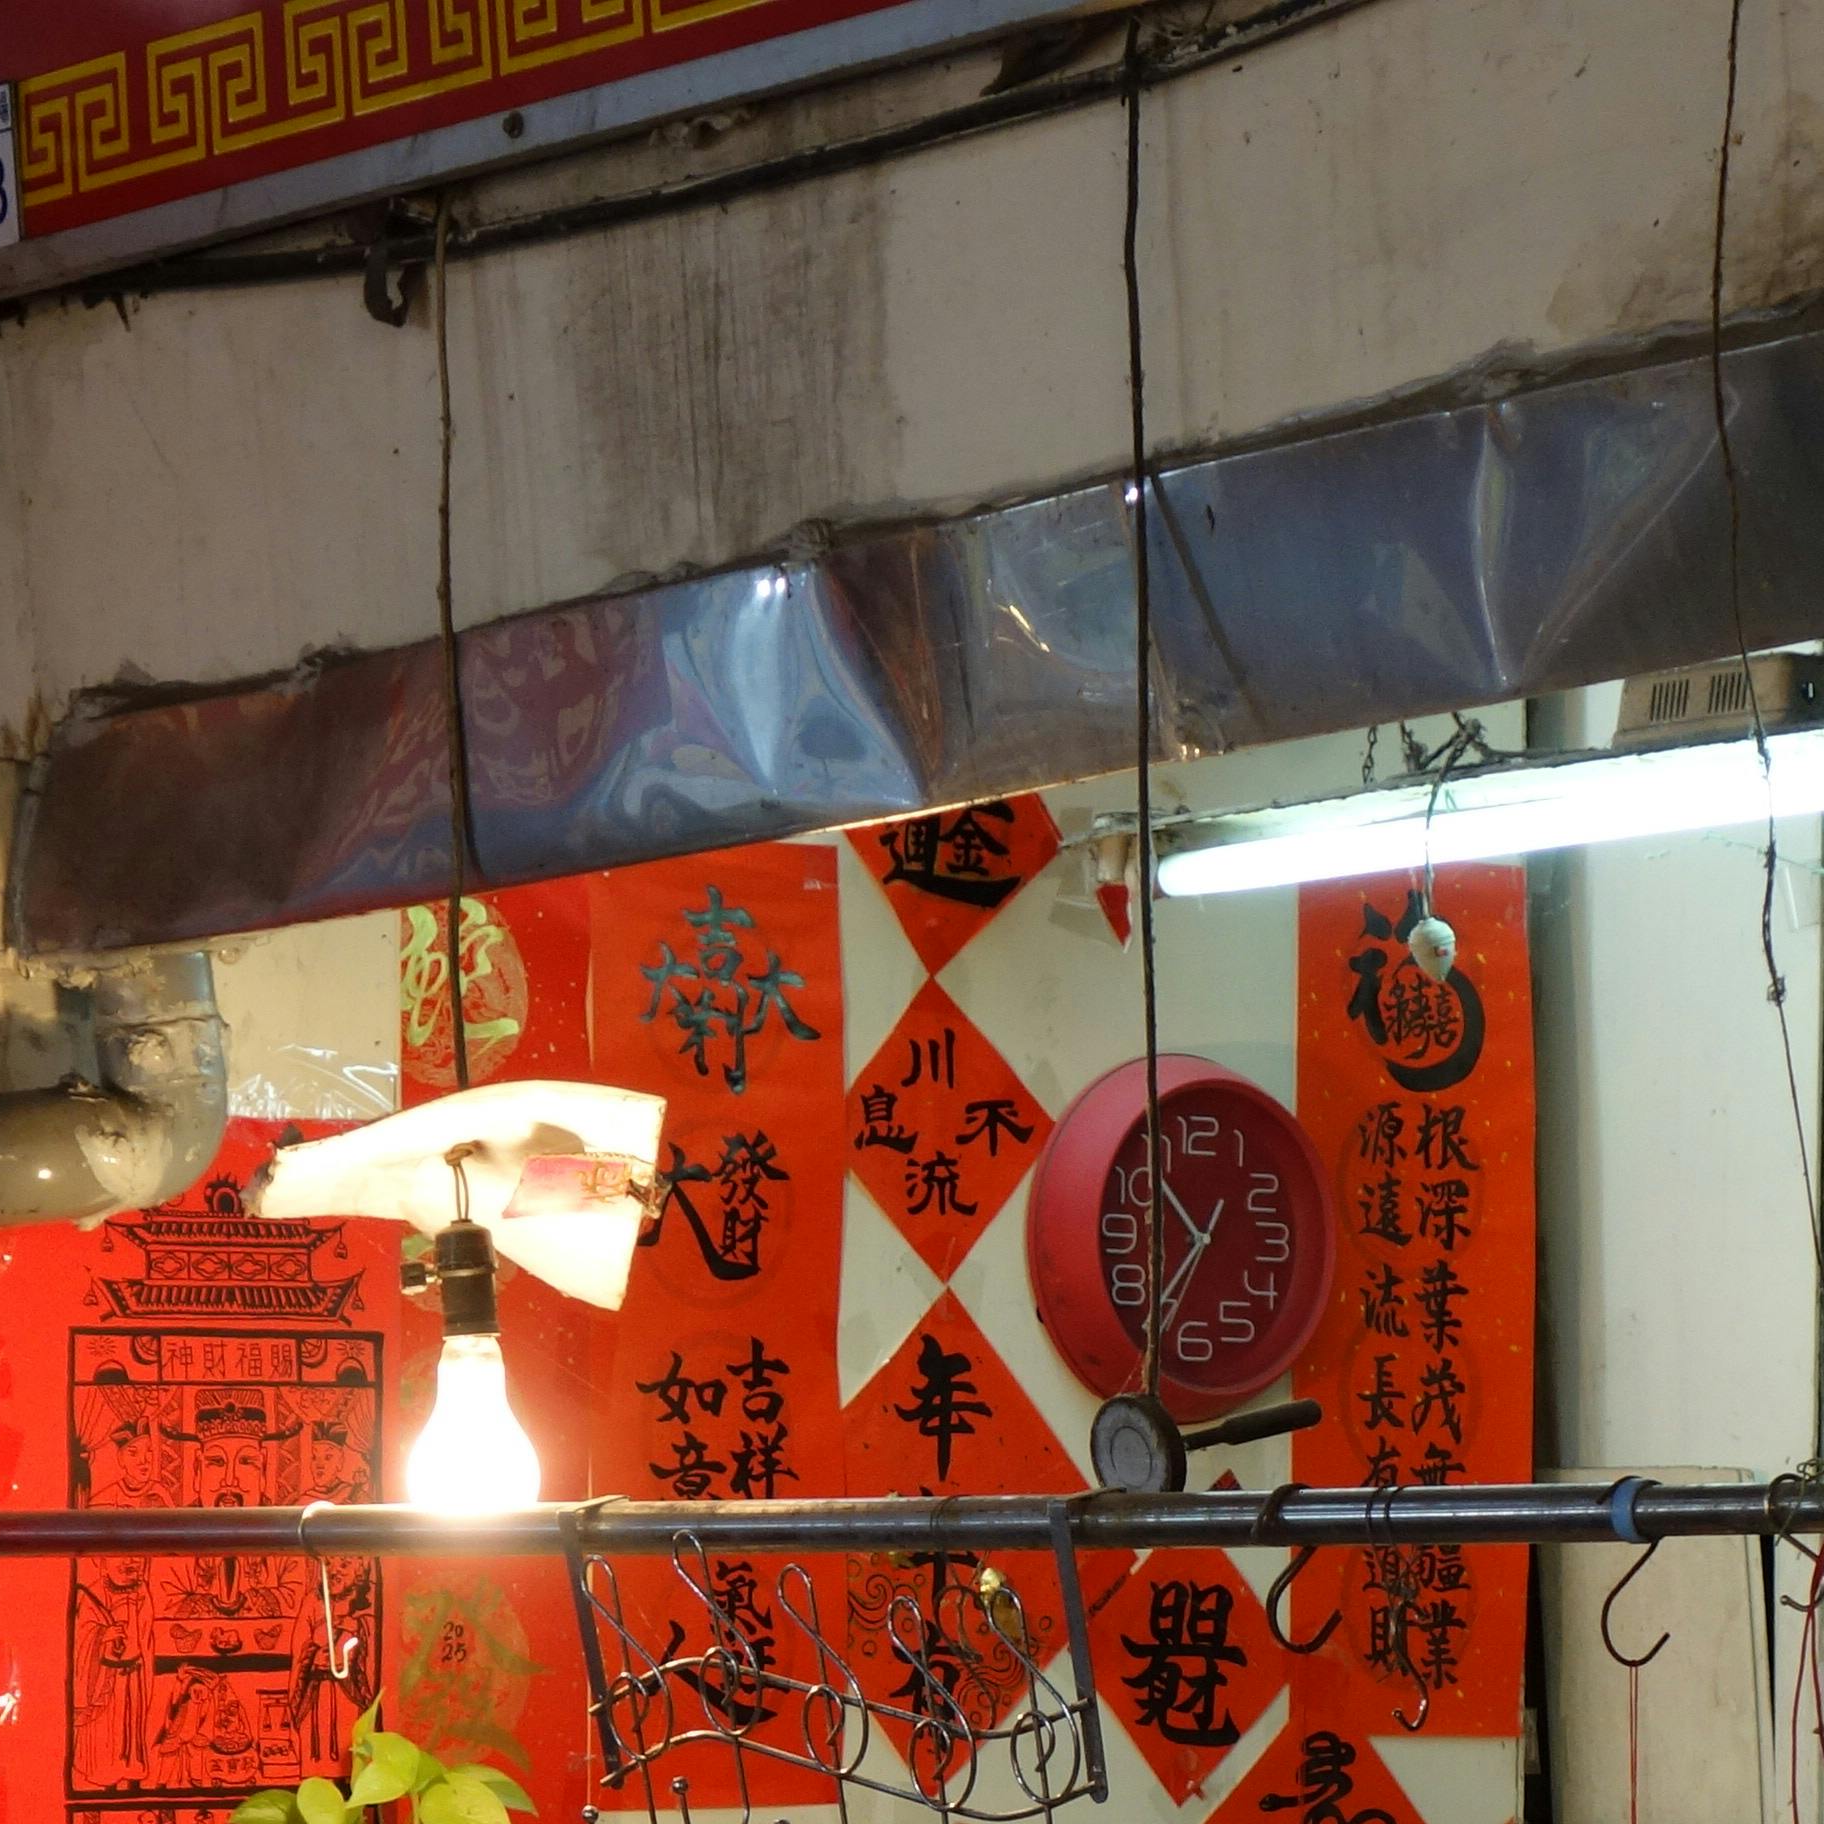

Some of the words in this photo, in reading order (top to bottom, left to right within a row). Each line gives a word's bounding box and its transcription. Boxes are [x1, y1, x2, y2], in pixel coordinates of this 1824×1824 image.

[1177, 1116, 1220, 1155] 12
[1233, 1129, 1243, 1167] 1
[1115, 1166, 1154, 1207] 10
[1248, 1173, 1279, 1213] 2
[1102, 1214, 1137, 1254] 9
[1256, 1222, 1289, 1262] 3
[1112, 1264, 1145, 1305] 8
[1244, 1270, 1278, 1311] 4
[1178, 1321, 1213, 1361] 6
[1220, 1302, 1255, 1342] 5
